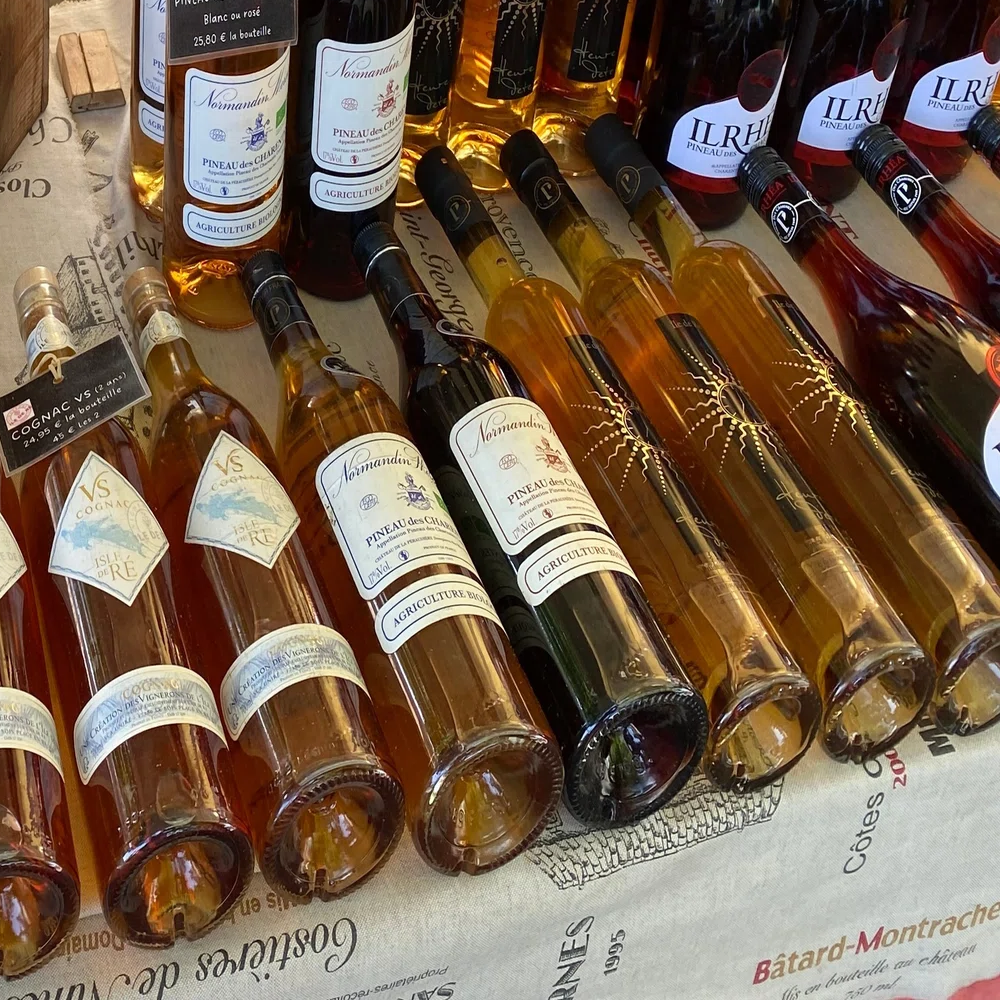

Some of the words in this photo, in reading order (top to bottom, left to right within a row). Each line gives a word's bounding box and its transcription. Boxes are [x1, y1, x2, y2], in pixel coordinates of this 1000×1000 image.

[203, 12, 228, 25] Blanc
[230, 11, 241, 20] ou
[243, 6, 261, 18] rosé
[193, 33, 217, 47] 25,80
[219, 32, 227, 43] €
[229, 31, 237, 41] la
[239, 25, 272, 40] bouteille
[193, 87, 270, 112] Normandin
[240, 156, 254, 169] des
[11, 402, 72, 441] COGNAC
[74, 389, 92, 403] VS
[94, 384, 104, 394] (2
[106, 371, 127, 386] ans)
[23, 427, 51, 448] 24,95
[54, 420, 62, 429] €
[64, 413, 76, 423] la
[77, 386, 122, 415] bouteille
[52, 433, 65, 444] 45
[67, 426, 76, 434] €
[77, 417, 92, 429] Les
[93, 411, 100, 419] 2
[78, 470, 111, 503] VS
[332, 447, 412, 498] Normandin
[507, 479, 548, 505] PINEAU
[76, 500, 131, 520] COGNAC
[365, 518, 407, 547] PINEAU
[375, 530, 406, 550] Appellation
[537, 546, 607, 581] AGRICULTURE
[392, 589, 466, 628] AGRICULTURE
[89, 707, 123, 739] CRÉATION
[138, 691, 185, 704] VIGNERONS
[843, 790, 886, 875] Côtes
[199, 917, 358, 983] Costières
[603, 928, 627, 977] 1995
[824, 958, 890, 989] bouteille
[893, 958, 913, 970] au
[918, 943, 978, 966] château
[138, 961, 180, 995] de
[804, 982, 822, 995] en
